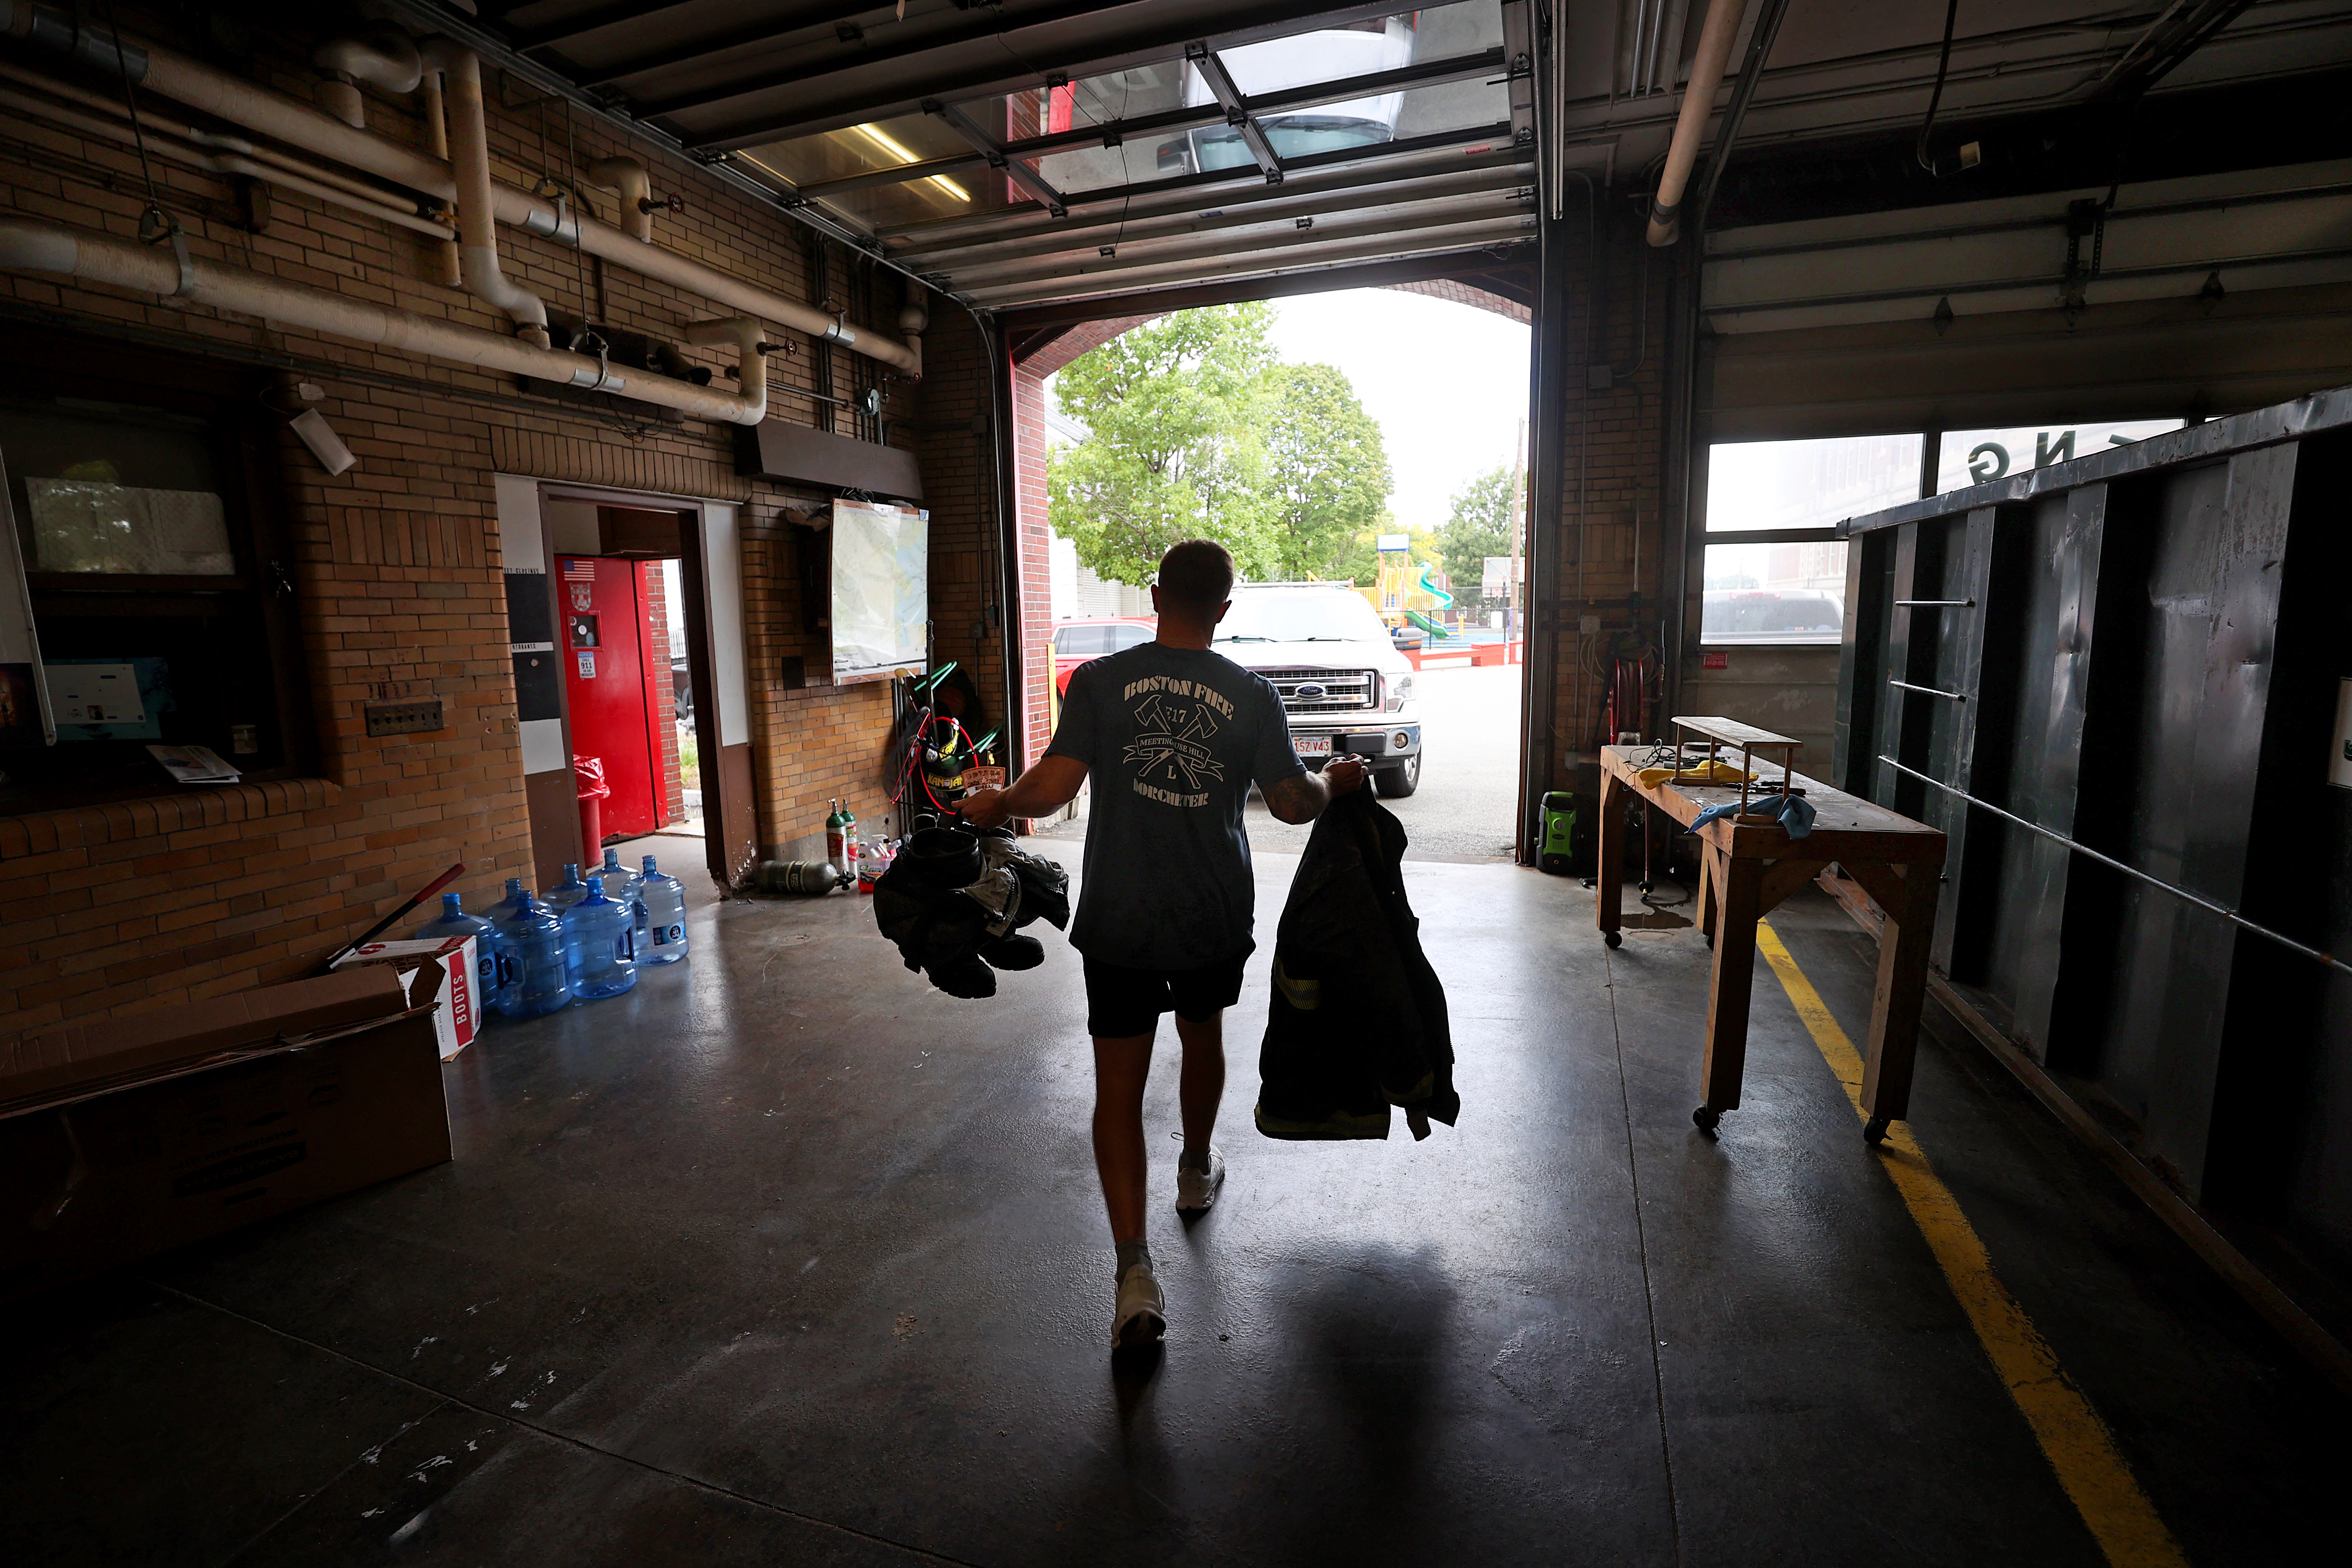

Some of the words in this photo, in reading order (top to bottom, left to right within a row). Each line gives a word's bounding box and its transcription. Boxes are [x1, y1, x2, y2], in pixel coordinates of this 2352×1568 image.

[1124, 675, 1192, 701] BOSTON
[1194, 683, 1234, 721] FIRE
[1188, 747, 1204, 759] HILL
[1295, 742, 1310, 752] 15Z
[1313, 741, 1329, 751] V43
[928, 775, 944, 787] KAN
[1133, 777, 1209, 808] DORCHETER
[453, 974, 467, 1025] BOOTS
[221, 1149, 300, 1178] BANKERS
